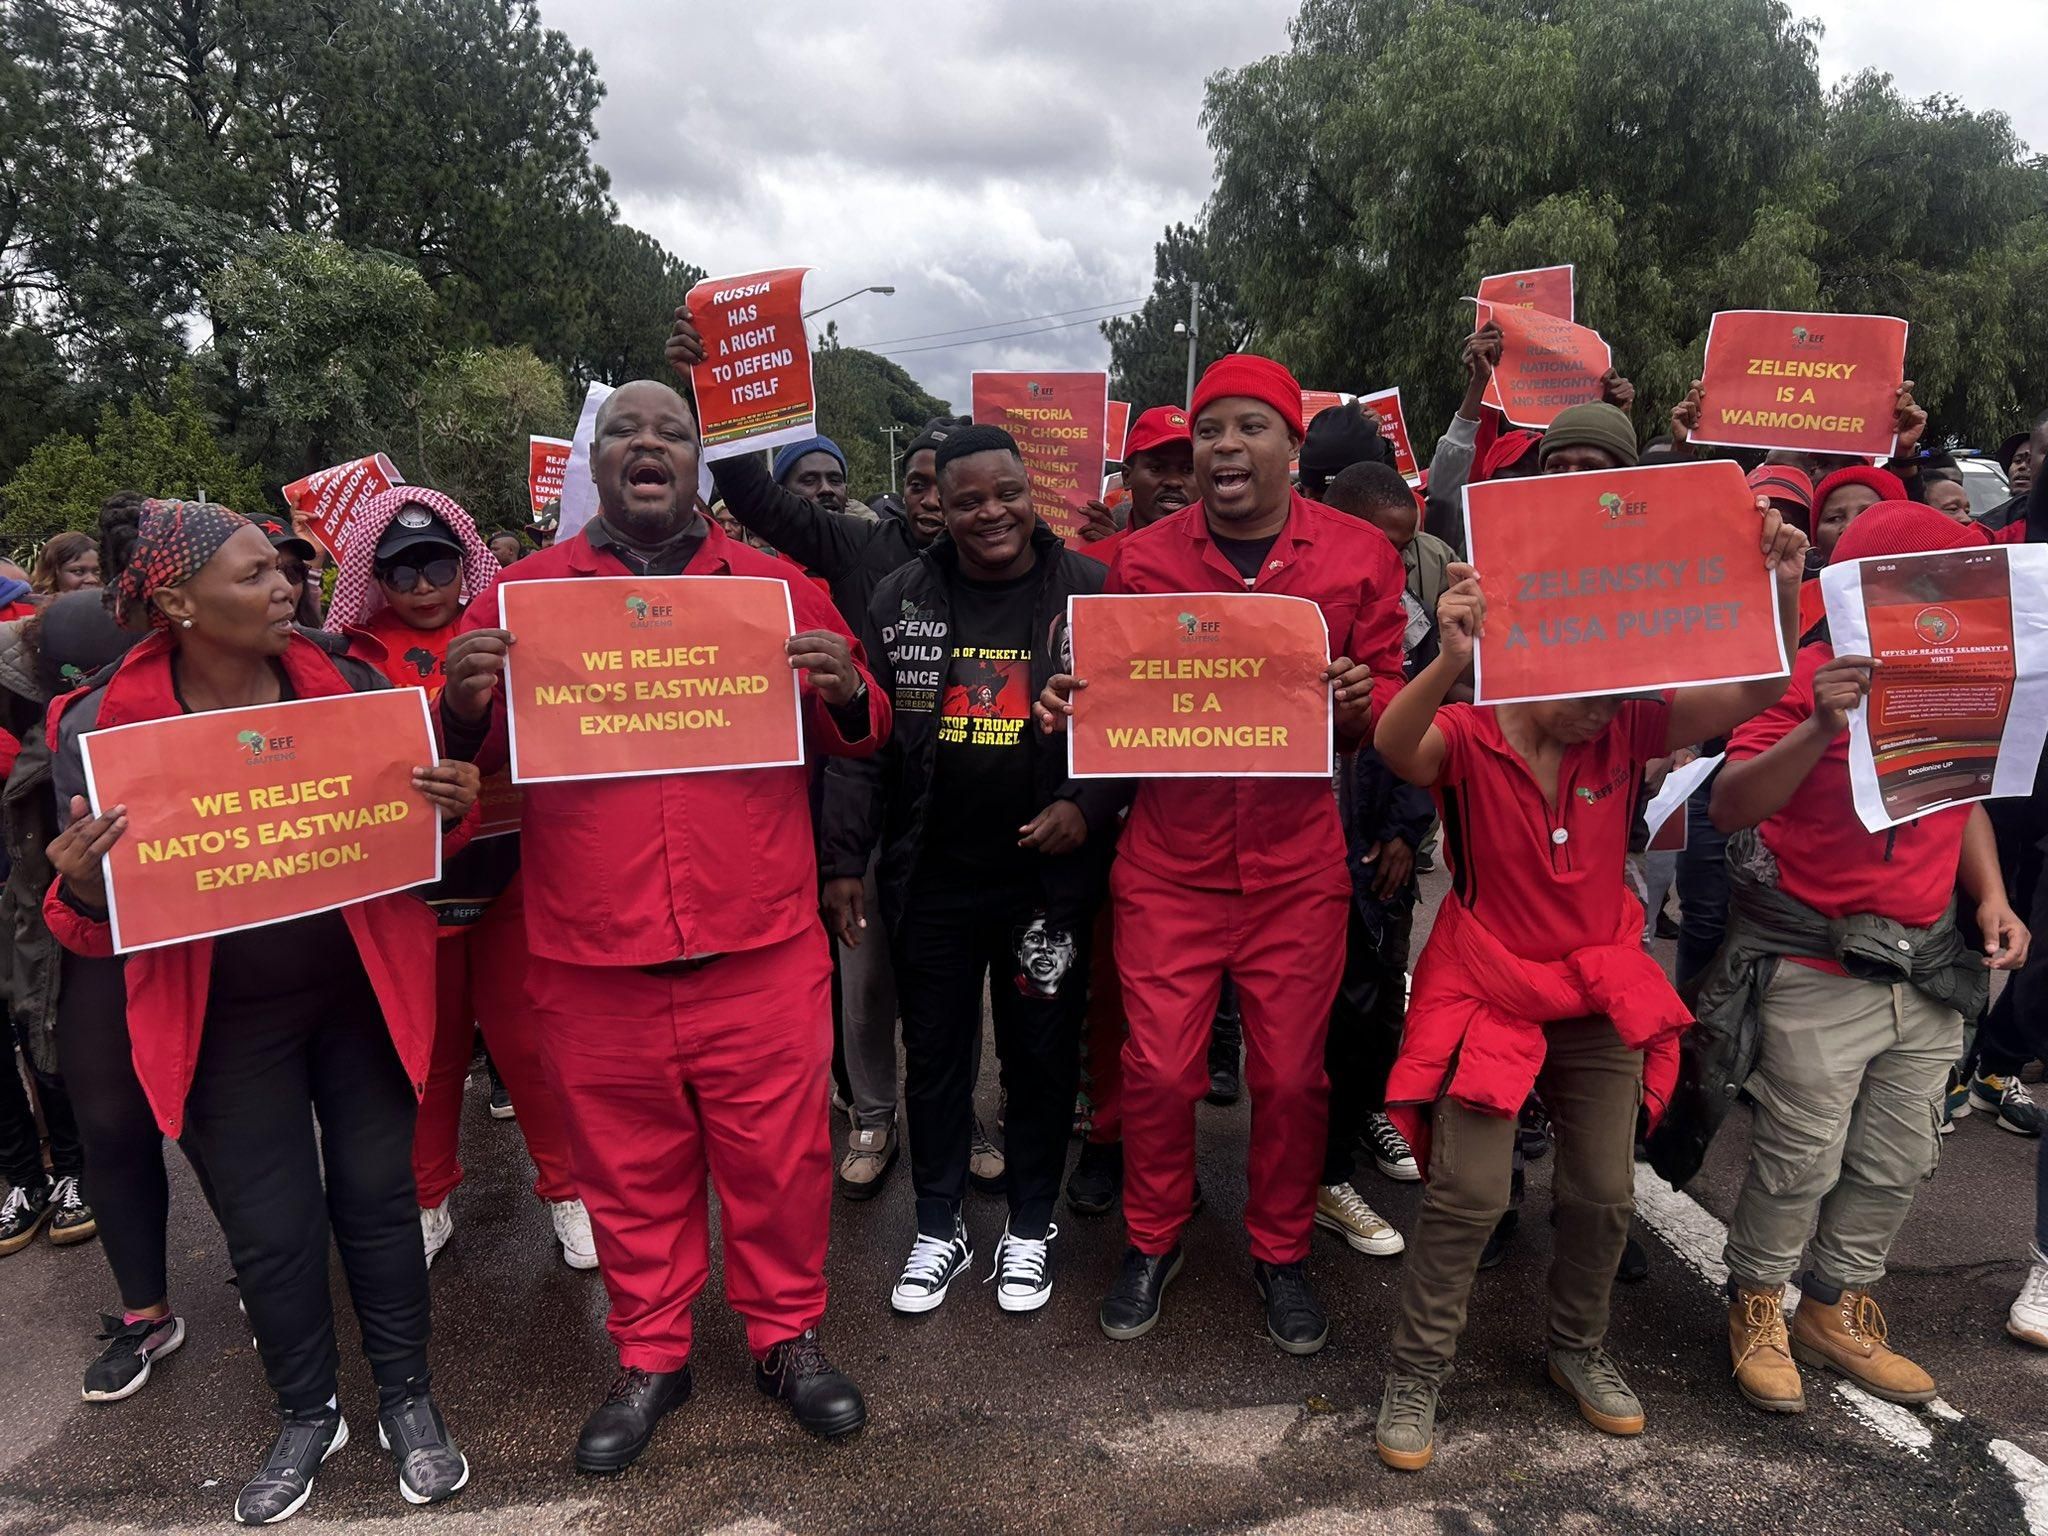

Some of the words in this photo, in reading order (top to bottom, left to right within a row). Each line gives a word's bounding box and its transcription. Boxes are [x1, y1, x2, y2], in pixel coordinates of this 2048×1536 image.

[713, 281, 770, 305] RUSSIA
[728, 304, 757, 327] HAS
[720, 338, 729, 356] A
[732, 325, 776, 352] RIGHT
[712, 364, 731, 383] TO
[735, 349, 792, 378] DEFEND
[1520, 361, 1586, 374] NATIONAL
[1747, 359, 1857, 379] ZELENSKY
[731, 378, 779, 404] ITSELF
[1776, 386, 1794, 403] IS
[1799, 388, 1815, 404] A
[1006, 409, 1072, 420] PRETORIA
[1721, 409, 1865, 433] WARMONGER
[1031, 427, 1088, 439] CHOOSE
[1017, 441, 1068, 456] OSITIVE
[546, 455, 567, 465] REJE
[1022, 458, 1079, 473] GNMENT
[1033, 475, 1079, 489] RUSSIA
[324, 466, 370, 536] EXPANSION,
[1030, 489, 1066, 504] AINST
[333, 519, 356, 551] SEEK
[350, 477, 379, 518] PEACE.
[1033, 503, 1069, 519] TERN
[1626, 502, 1648, 516] EFF
[1516, 559, 1690, 602] ZELENSKY
[1697, 556, 1726, 585] IS
[652, 606, 673, 617] EFF
[882, 620, 948, 644] DFEND
[1201, 621, 1220, 632] EFF
[1505, 623, 1531, 650] A
[1539, 614, 1608, 647] USA
[1617, 602, 1744, 640] PUPPET
[581, 652, 624, 671] WE
[630, 645, 719, 669] REJECT
[963, 647, 975, 658] OF
[979, 648, 1018, 660] PICKET
[1920, 647, 1954, 656] REJECTS
[896, 671, 940, 685] ANCE
[1129, 657, 1267, 680] ZELENSKY
[535, 683, 628, 705] NATO'S
[635, 675, 769, 700] EASTWARD
[1172, 693, 1194, 713] IS
[1201, 692, 1222, 713] A
[579, 709, 731, 736] EXPANSION.
[974, 719, 1024, 732] TRUMP
[269, 735, 294, 750] EFF
[938, 728, 968, 743] STOP
[972, 731, 1020, 746] ISRAEL
[1106, 726, 1288, 748] WARMONGER
[246, 752, 296, 766] GAUTENG
[1907, 763, 1942, 776] Decolonize
[1943, 761, 1953, 769] UP
[192, 792, 242, 817] WE
[249, 775, 352, 810] REJECT
[137, 827, 250, 864] NATO'S
[257, 801, 409, 846] EASTWARD
[196, 843, 369, 891] EXPANSION.
